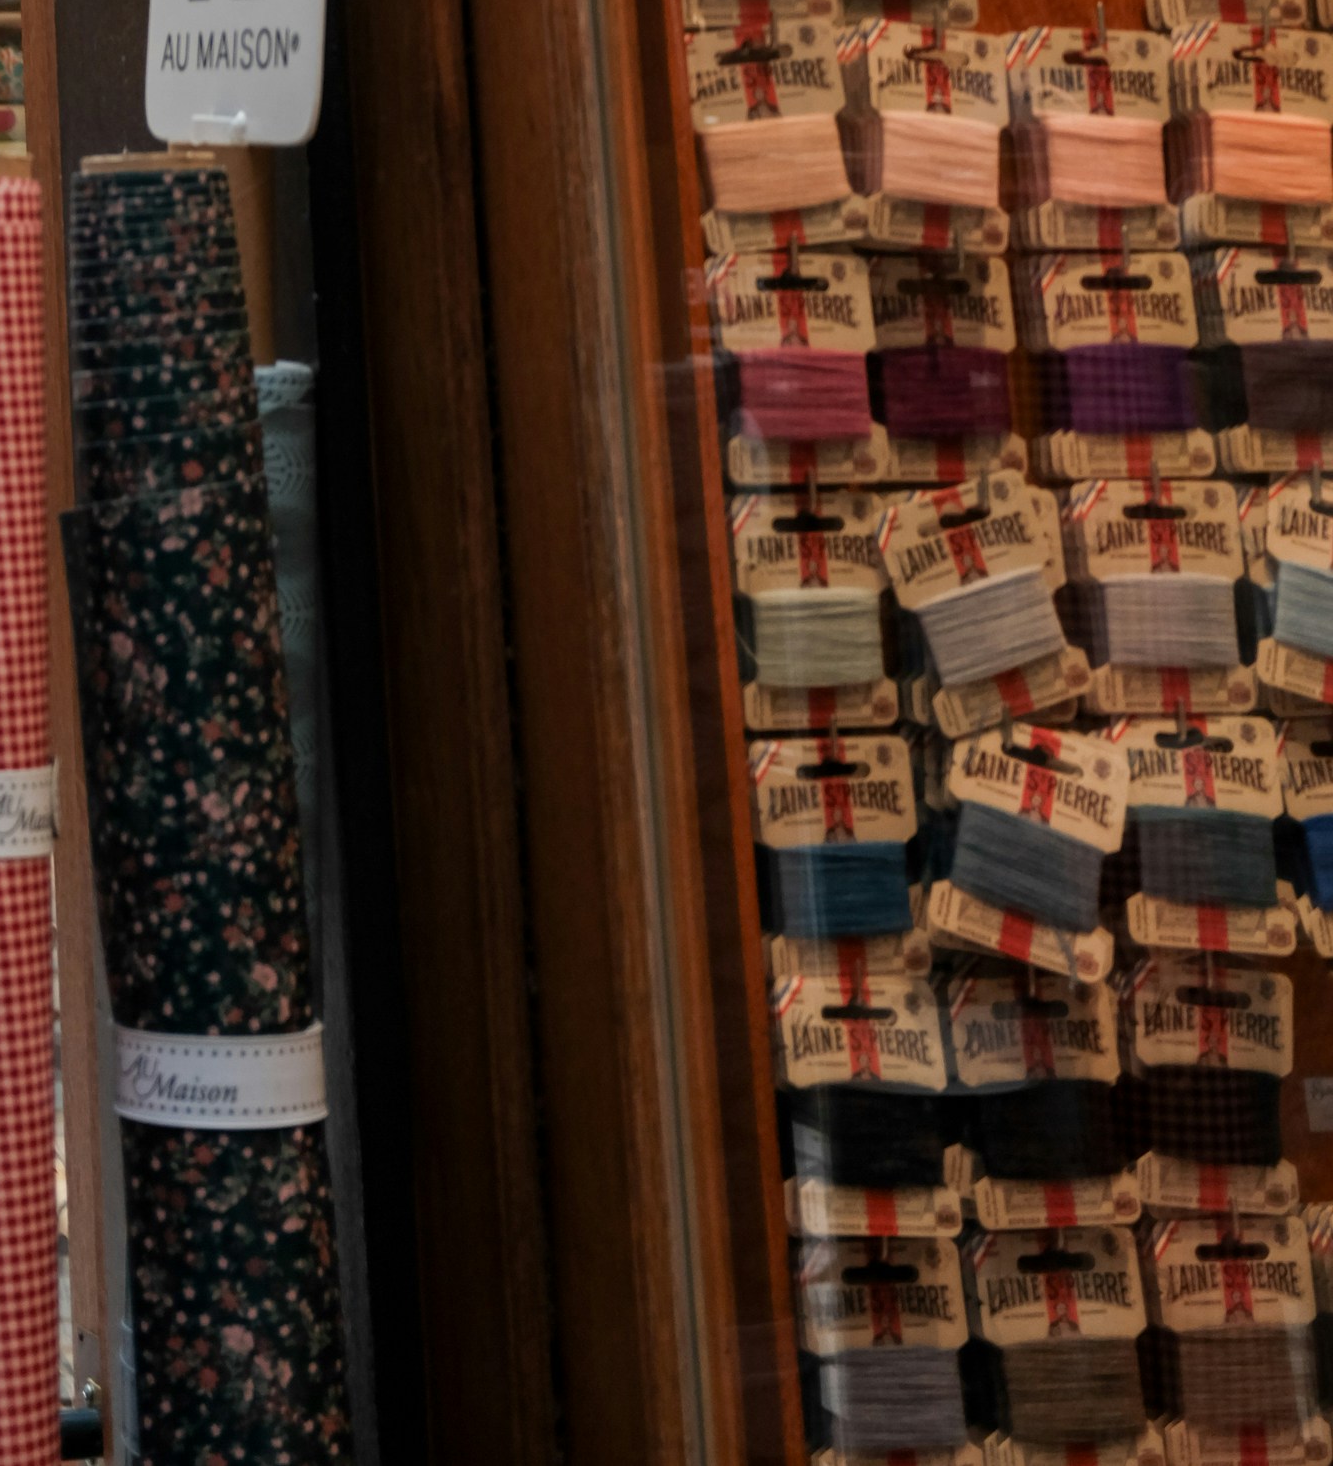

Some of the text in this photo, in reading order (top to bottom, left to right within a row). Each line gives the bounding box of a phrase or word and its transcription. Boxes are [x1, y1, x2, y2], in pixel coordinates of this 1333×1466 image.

[161, 32, 190, 71] AU
[1096, 520, 1145, 555] LAINE
[1171, 520, 1232, 555] PIERRE
[1281, 505, 1331, 540] LAINE
[898, 536, 948, 584] LAINE
[970, 513, 1032, 546] PIERRE
[963, 747, 1021, 786] LAINE
[1046, 772, 1111, 828] PIERRE
[1126, 747, 1179, 783] LAINE
[1202, 752, 1269, 794] PIERRE
[768, 781, 819, 821] LAINE
[845, 779, 904, 816] PIERRE
[791, 1020, 844, 1063] LAINE
[870, 1027, 935, 1068] PIERRE
[1219, 1006, 1283, 1051] PIERRE
[151, 1072, 238, 1104] Maison
[986, 1274, 1040, 1314] LAINE
[1068, 1270, 1132, 1307] PIERRE
[1168, 1262, 1220, 1301] LAINE
[1242, 1261, 1302, 1298] PIERRE
